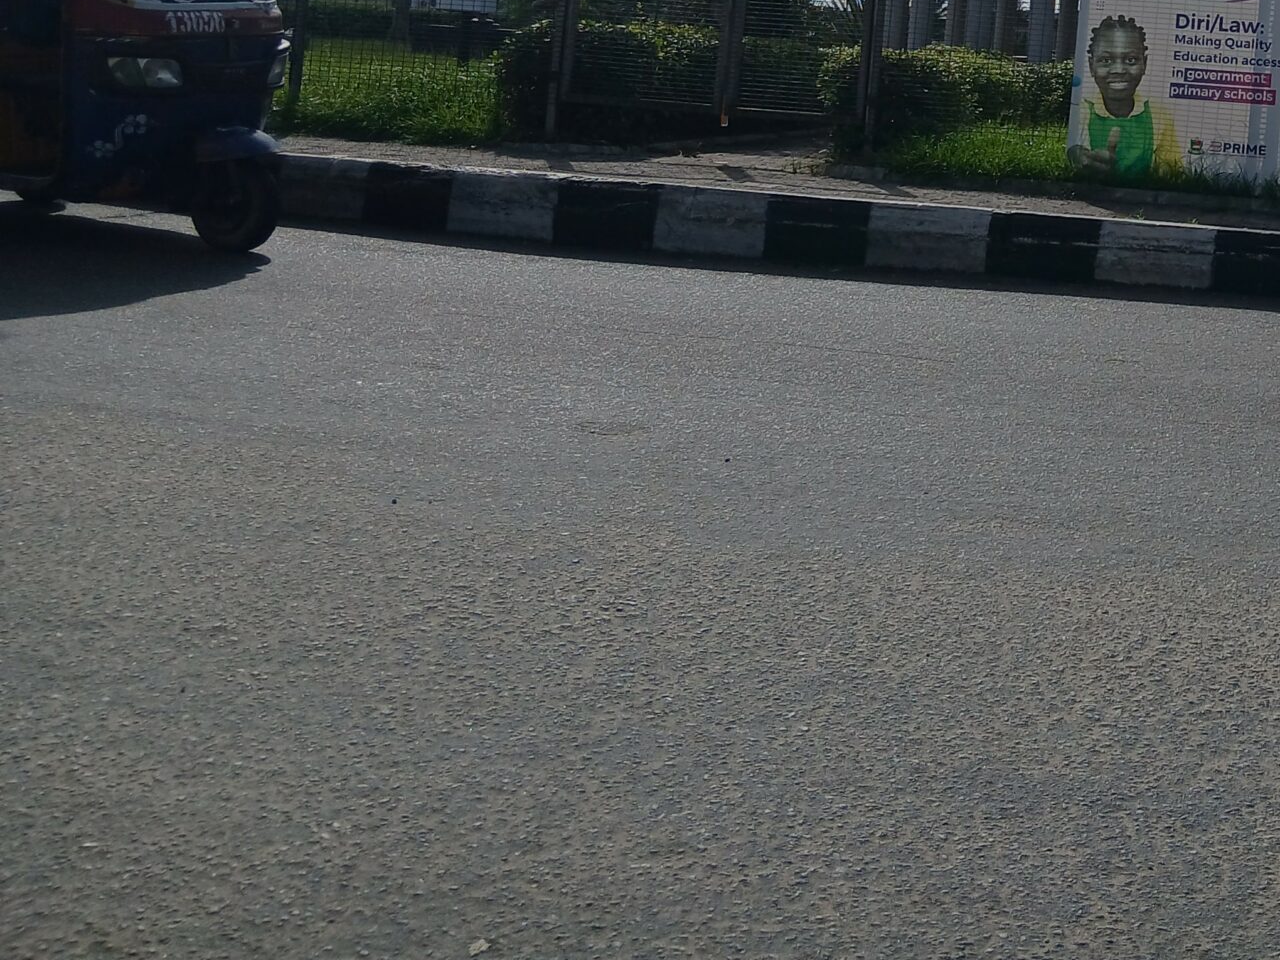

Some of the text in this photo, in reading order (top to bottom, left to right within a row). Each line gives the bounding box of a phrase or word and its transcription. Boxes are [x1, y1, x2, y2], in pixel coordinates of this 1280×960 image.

[1175, 13, 1265, 34] Diri/Law:
[1174, 34, 1272, 53] Making Quality
[1173, 50, 1238, 66] Education
[1171, 66, 1267, 84] in government
[1170, 84, 1273, 103] primary schools
